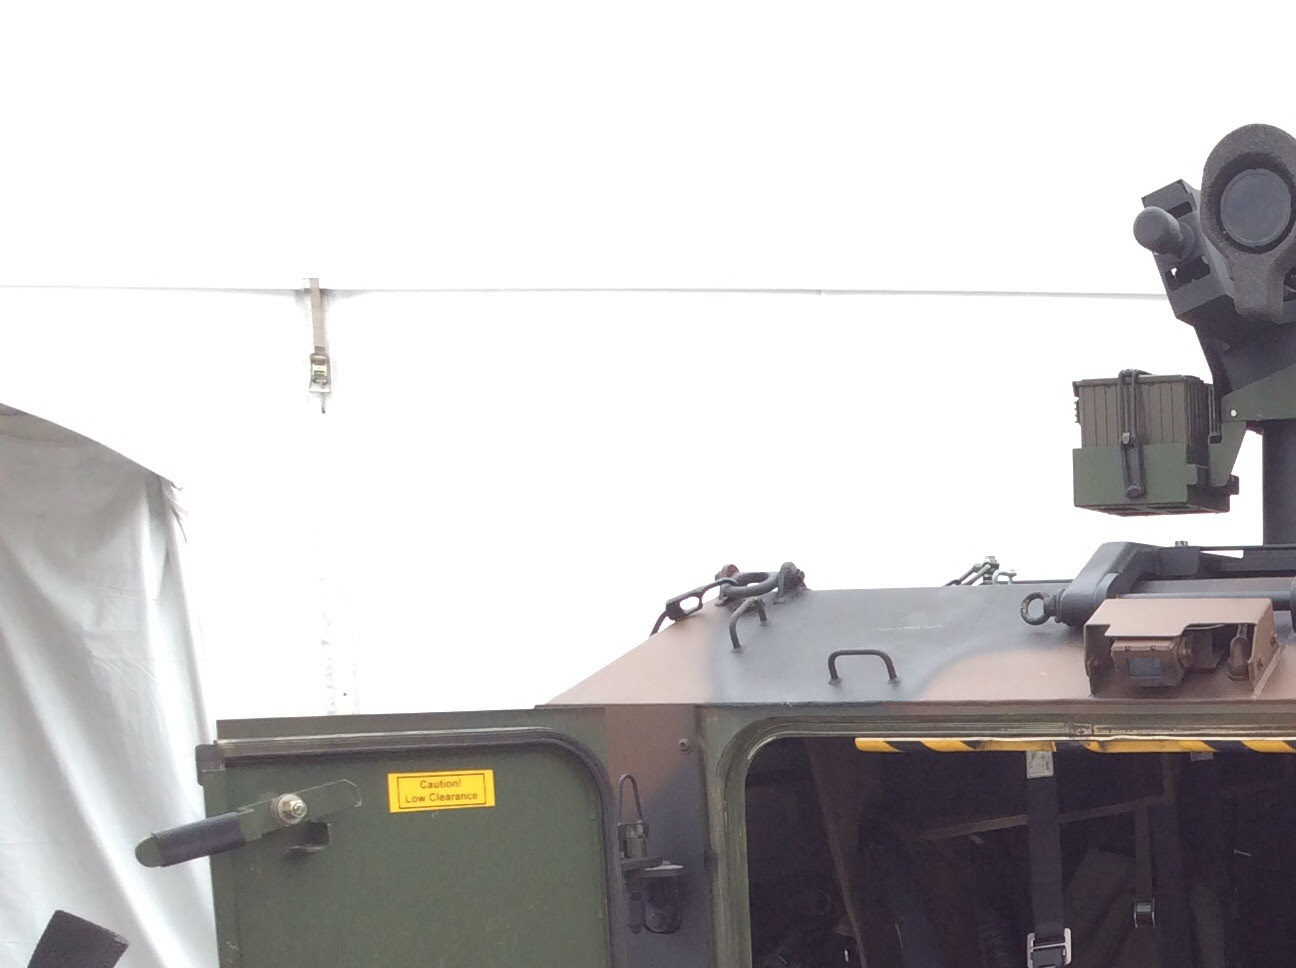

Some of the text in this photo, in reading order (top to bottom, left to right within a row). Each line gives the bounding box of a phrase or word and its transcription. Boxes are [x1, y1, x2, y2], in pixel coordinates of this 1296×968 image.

[420, 778, 462, 789] Caution!
[405, 792, 479, 804] Low Clearance
